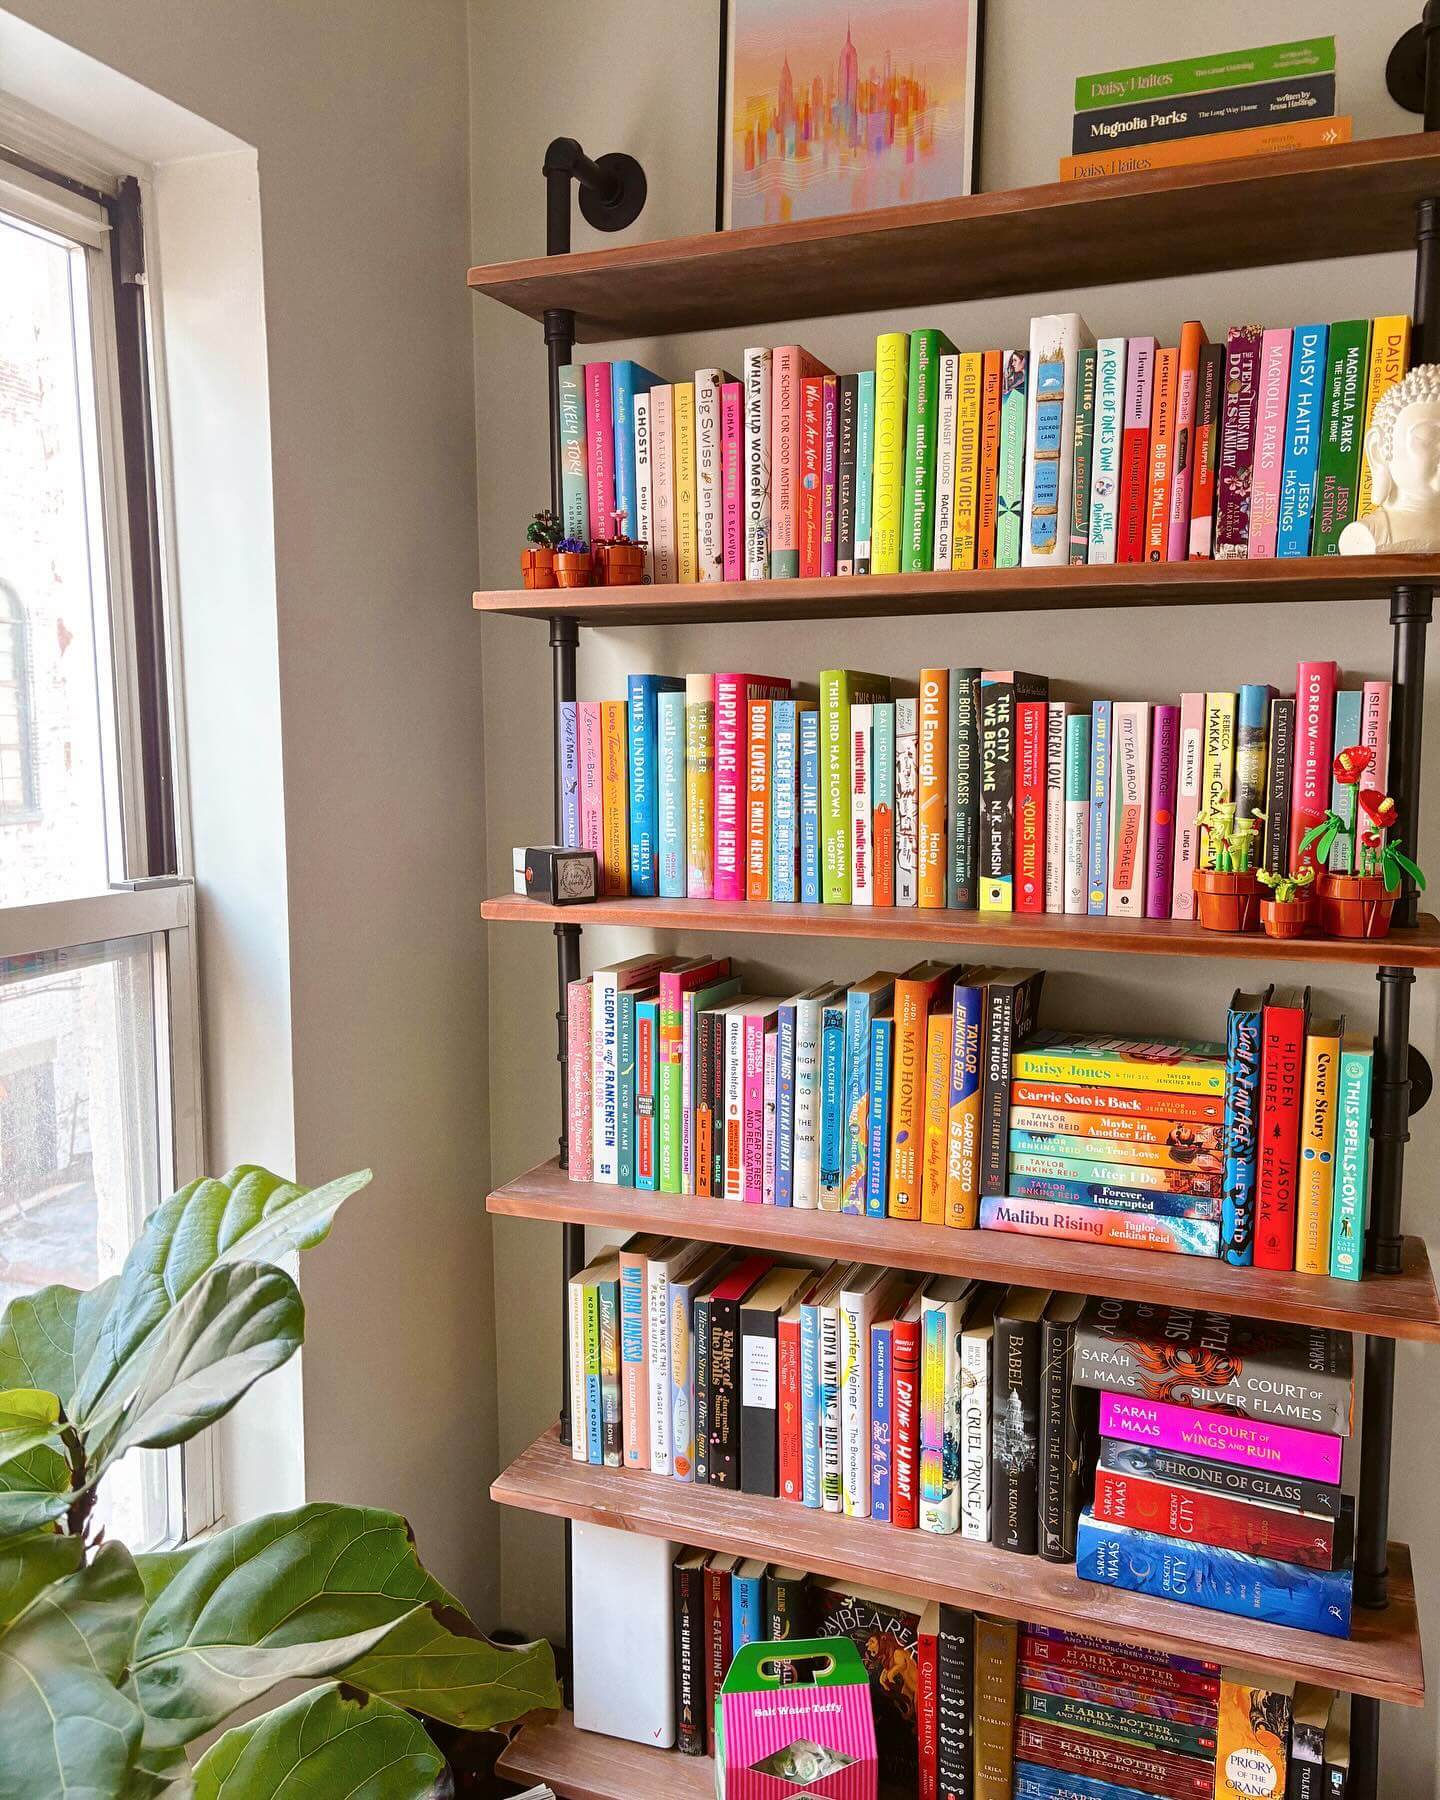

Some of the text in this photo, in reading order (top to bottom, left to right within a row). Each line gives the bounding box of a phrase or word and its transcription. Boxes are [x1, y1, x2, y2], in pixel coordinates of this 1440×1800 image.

[1091, 111, 1187, 138] Magnolia Parks
[751, 356, 761, 393] WHAT
[1294, 334, 1317, 455] DAISY HAITES
[563, 394, 578, 434] LIKELY
[751, 400, 761, 434] WILD
[825, 402, 834, 438] Cursed
[1329, 360, 1343, 442] THE LONG WAY HOME
[1340, 347, 1359, 452] MAGNOLIA PARKS
[638, 407, 647, 464] GHOSTS
[699, 389, 714, 467] Big Swiss
[780, 354, 790, 510] THE SCHOOL FOR GOOD MOTHERS
[843, 418, 851, 454] PARTS
[567, 439, 583, 478] STORY
[824, 441, 833, 473] Bunny
[939, 359, 954, 559] OUTLINE RACHEL CUSK
[751, 501, 761, 521] DO
[1151, 444, 1167, 545] BIG GIRL SMALL TOWN
[1282, 470, 1296, 531] HASTINGS
[1297, 483, 1310, 517] JESSA
[1321, 476, 1336, 533] HASTINGS
[1336, 486, 1349, 520] JESSA
[701, 512, 714, 556] Beagin
[823, 511, 833, 542] Chung
[841, 509, 849, 543] CLARK
[1308, 674, 1320, 738] SORROW
[829, 680, 840, 818] THIS BIRD HAS FLOWN
[983, 703, 995, 791] WE BECAME
[997, 694, 1009, 763] THE CITY
[633, 738, 644, 802] UNDOING
[718, 683, 736, 873] HAPPY PLACE EMILY HENRY
[751, 705, 766, 875] BOOK LOVERS EMILY HENRY
[1305, 760, 1316, 798] BLISS
[641, 832, 649, 870] CHERYL
[828, 838, 837, 870] HOFFS
[836, 829, 844, 878] SUSANNA
[992, 801, 1001, 875] N. K. JEMISIN
[954, 1002, 966, 1091] JENKINS REID
[966, 1023, 978, 1074] TAYLOR
[991, 998, 1002, 1081] EVELYN HUGO
[603, 988, 615, 1147] CLEOPATRA and FRANKENSTEIN
[729, 1058, 738, 1100] Moshfegh
[1025, 1060, 1111, 1079] Daisy Jones
[780, 1023, 791, 1171] EARTHLINGS SAYAKA MURATA
[1018, 1088, 1142, 1111] Carrie Soto is Back
[1341, 1081, 1360, 1214] THIS SPELLS LOVE
[996, 1208, 1103, 1235] Malibu Rising
[1109, 1229, 1169, 1244] Jenkins Reid
[1125, 1221, 1155, 1232] Taylor
[623, 1267, 642, 1362] MY DARK VANESSA
[1007, 1335, 1023, 1389] BABEL
[1082, 1350, 1129, 1367] SARAH
[1082, 1368, 1135, 1386] J. MAAS
[846, 1308, 860, 1496] Jennifer Weiner The Breakaway
[1191, 1387, 1322, 1422] SILVER FLAMES
[1229, 1375, 1323, 1400] A COURT OF
[1049, 1338, 1062, 1525] OLIVIE BLAKE THE ATLAS SIX
[1108, 1417, 1160, 1436] J. MAAS
[1113, 1403, 1157, 1421] SARAH
[898, 1444, 911, 1455] H
[898, 1461, 911, 1499] MART
[1156, 1460, 1301, 1501] THRONE OF GLASS
[682, 1630, 691, 1705] HUNGER GAMES
[754, 1703, 844, 1718] Salt Water Taffy
[1064, 1704, 1171, 1735] HARRY POTTER
[1230, 1755, 1273, 1774] PRIORY
